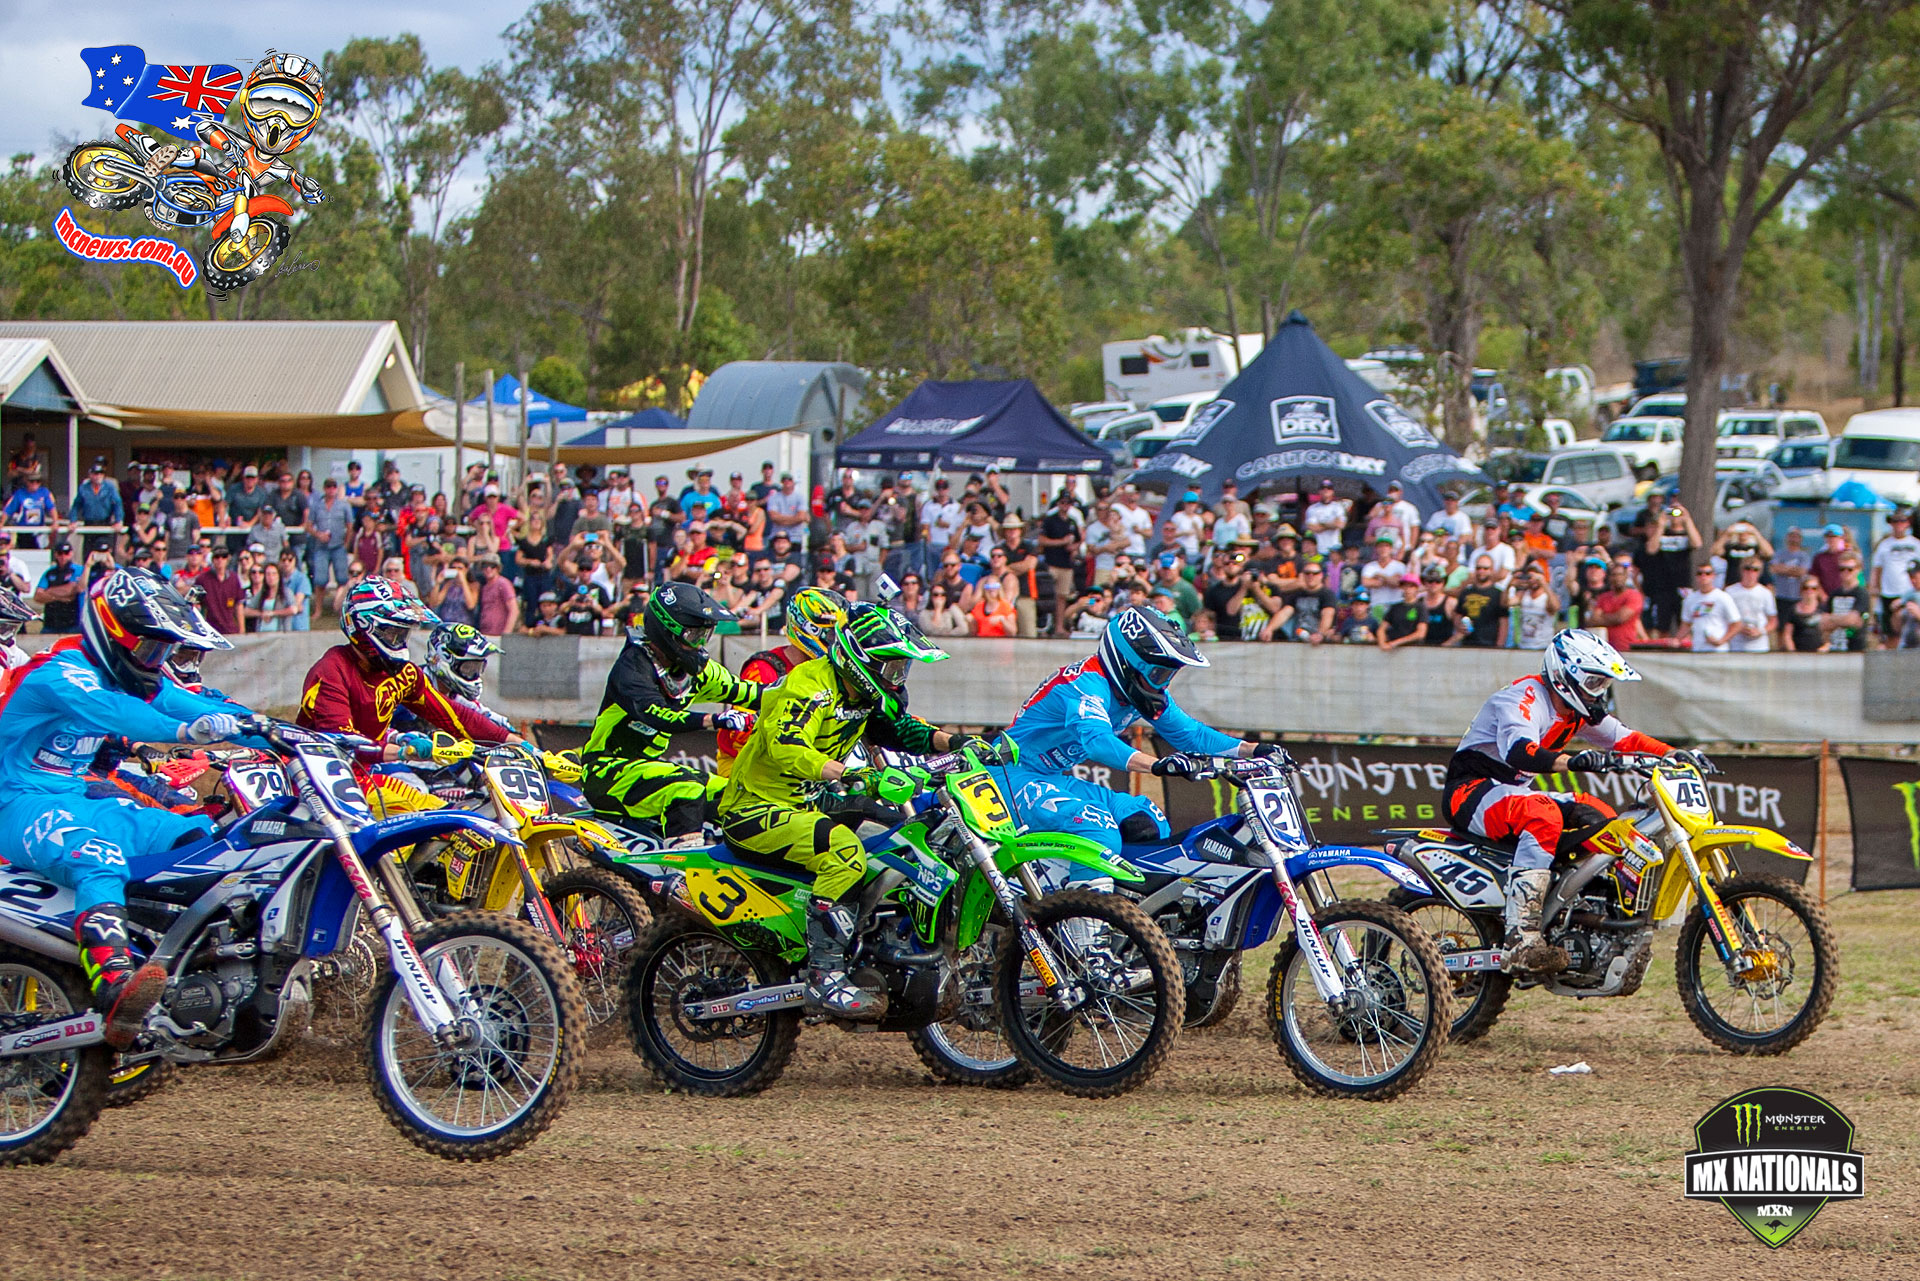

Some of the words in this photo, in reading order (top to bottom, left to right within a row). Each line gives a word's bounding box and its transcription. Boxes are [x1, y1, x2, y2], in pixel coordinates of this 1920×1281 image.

[1280, 417, 1332, 437] DRY
[1236, 450, 1341, 481] CARLTON
[1338, 451, 1387, 476] DRY
[325, 759, 365, 803] 2
[499, 768, 547, 802] 95
[1676, 781, 1708, 808] 45
[973, 782, 1008, 822] 3
[251, 820, 287, 836] YAMAHA
[1202, 837, 1234, 861] YAMAHA
[1318, 849, 1351, 858] YAMAHA
[917, 864, 944, 892] NPS
[1432, 860, 1494, 897] 45
[699, 875, 748, 920] 3
[1298, 918, 1331, 978] DUNLOP
[392, 938, 438, 1006] DUNLOP
